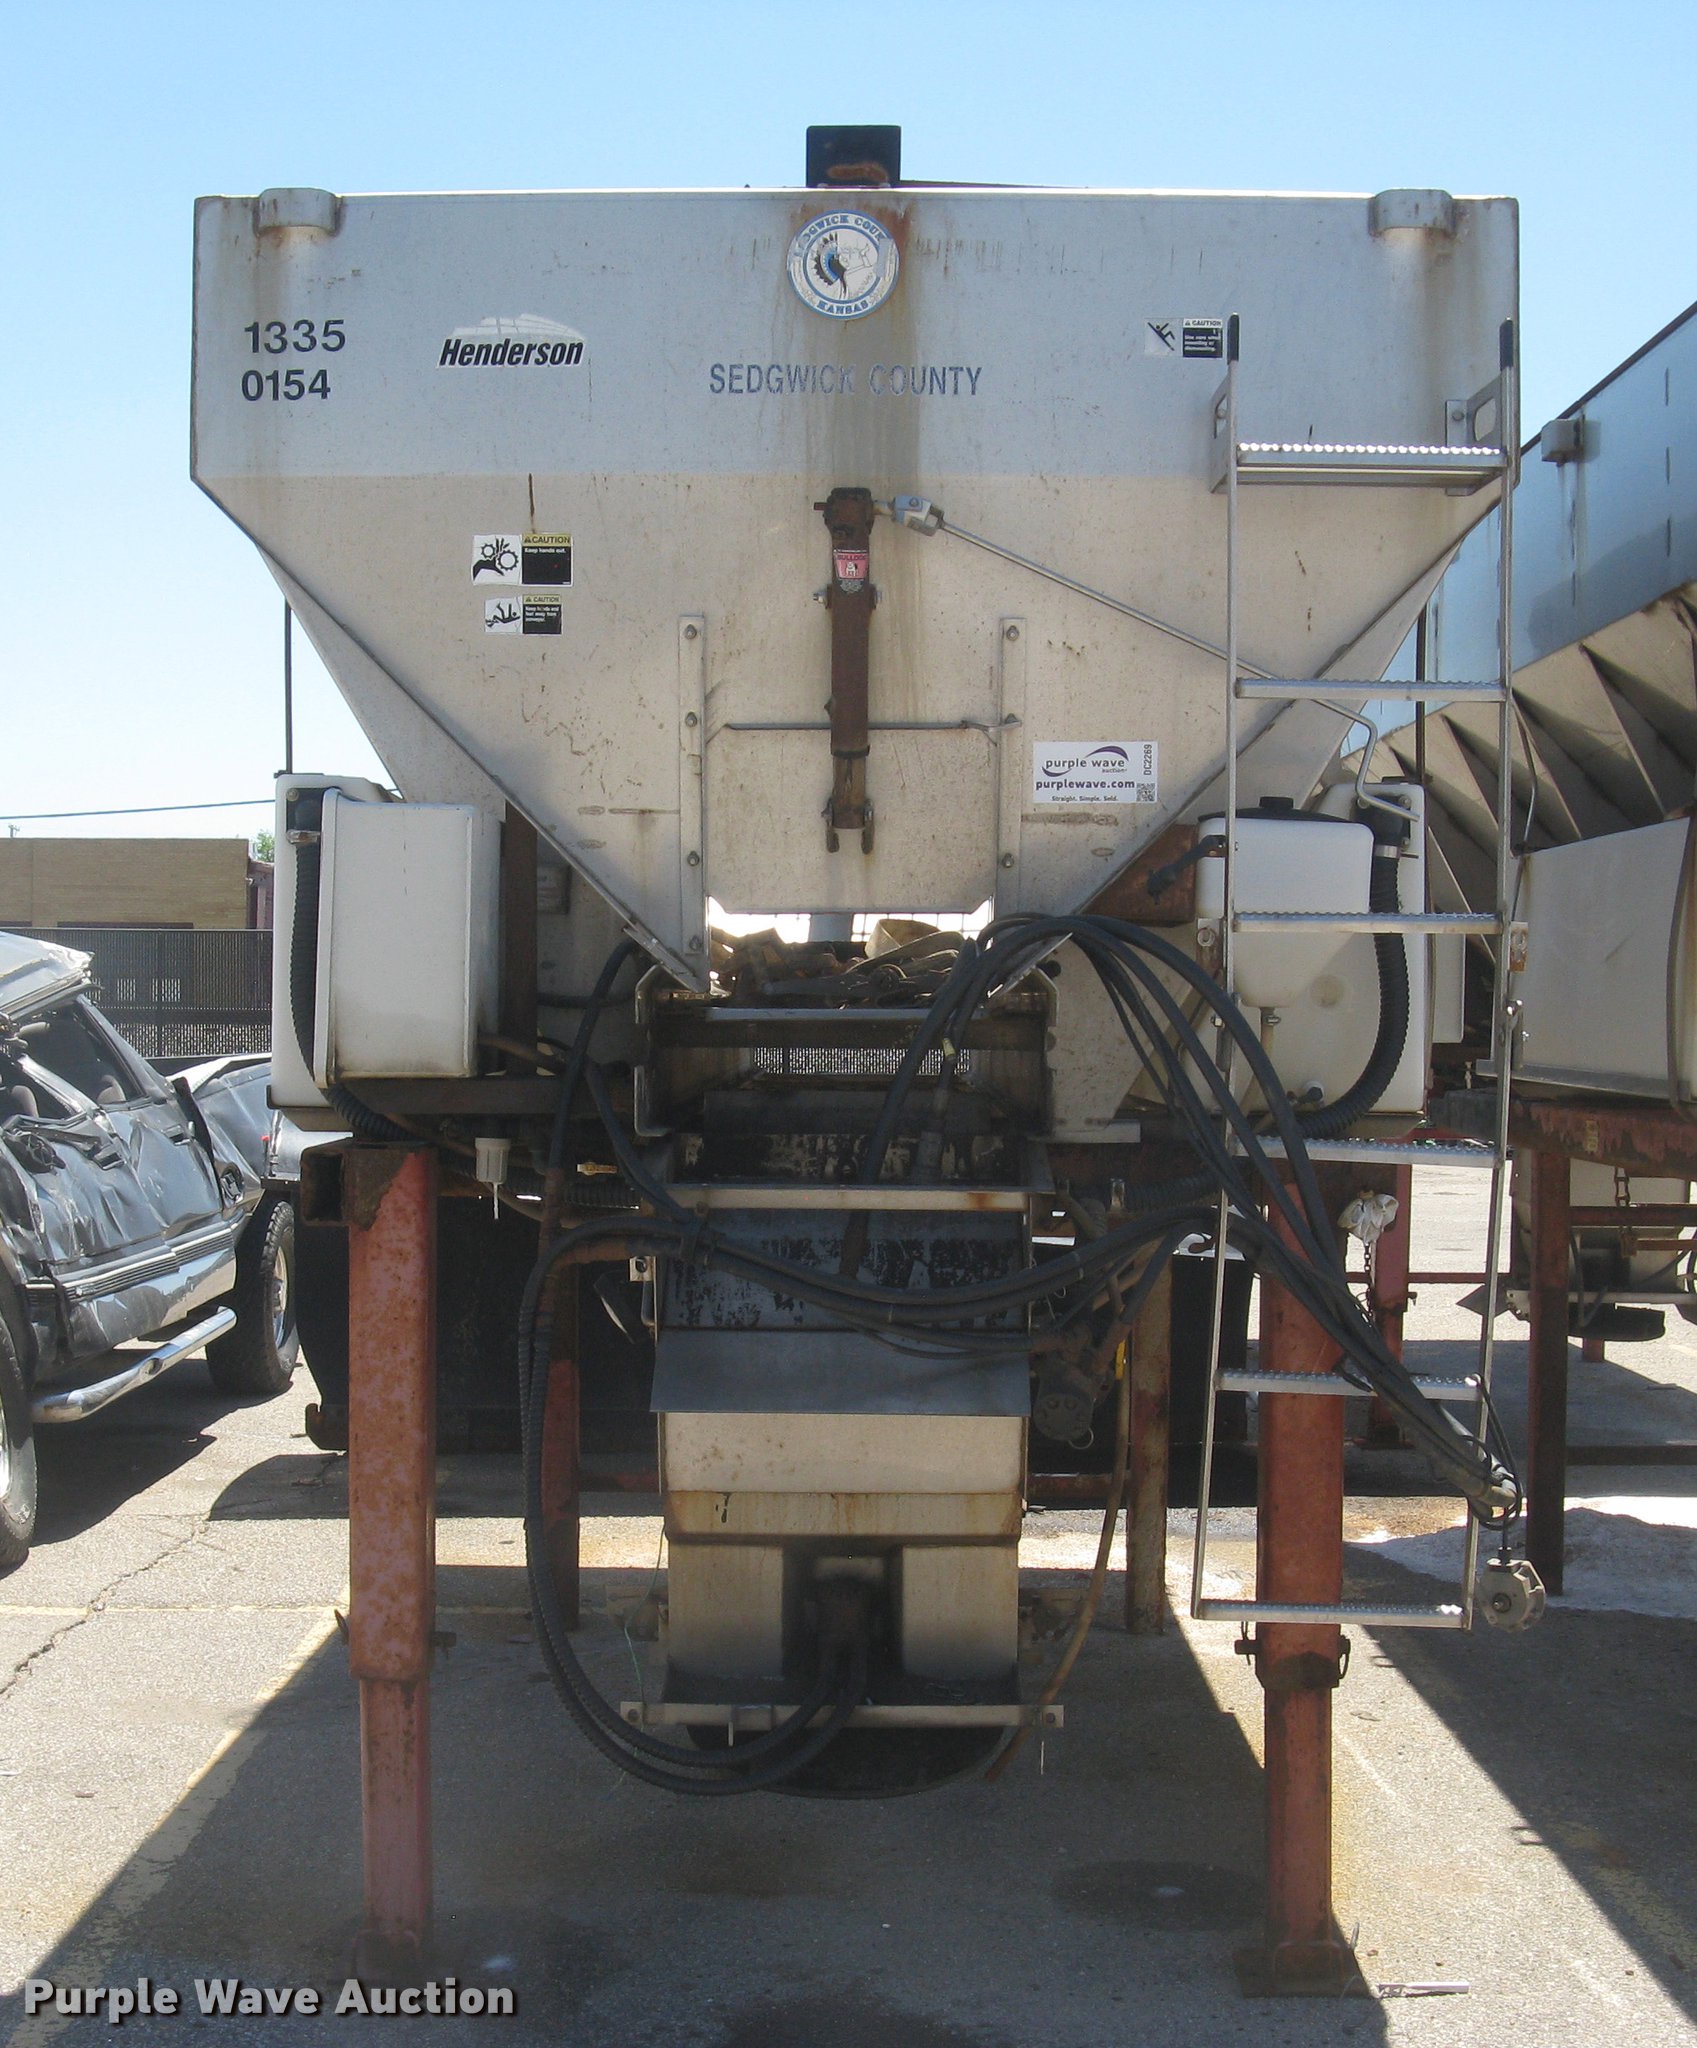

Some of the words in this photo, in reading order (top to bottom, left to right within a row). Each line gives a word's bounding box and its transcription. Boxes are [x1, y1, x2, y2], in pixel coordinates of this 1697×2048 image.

[817, 300, 869, 315] KANSAS
[244, 319, 346, 354] 1335
[439, 338, 584, 366] Henderson
[242, 369, 331, 401] 0154
[709, 363, 856, 395] SEDGWICK
[868, 363, 982, 396] COUNTY
[532, 536, 570, 544] CAUTION
[1045, 758, 1087, 769] purple
[1091, 760, 1125, 768] wave
[1143, 744, 1152, 776] DC2269
[1035, 779, 1135, 790] purplewave.com
